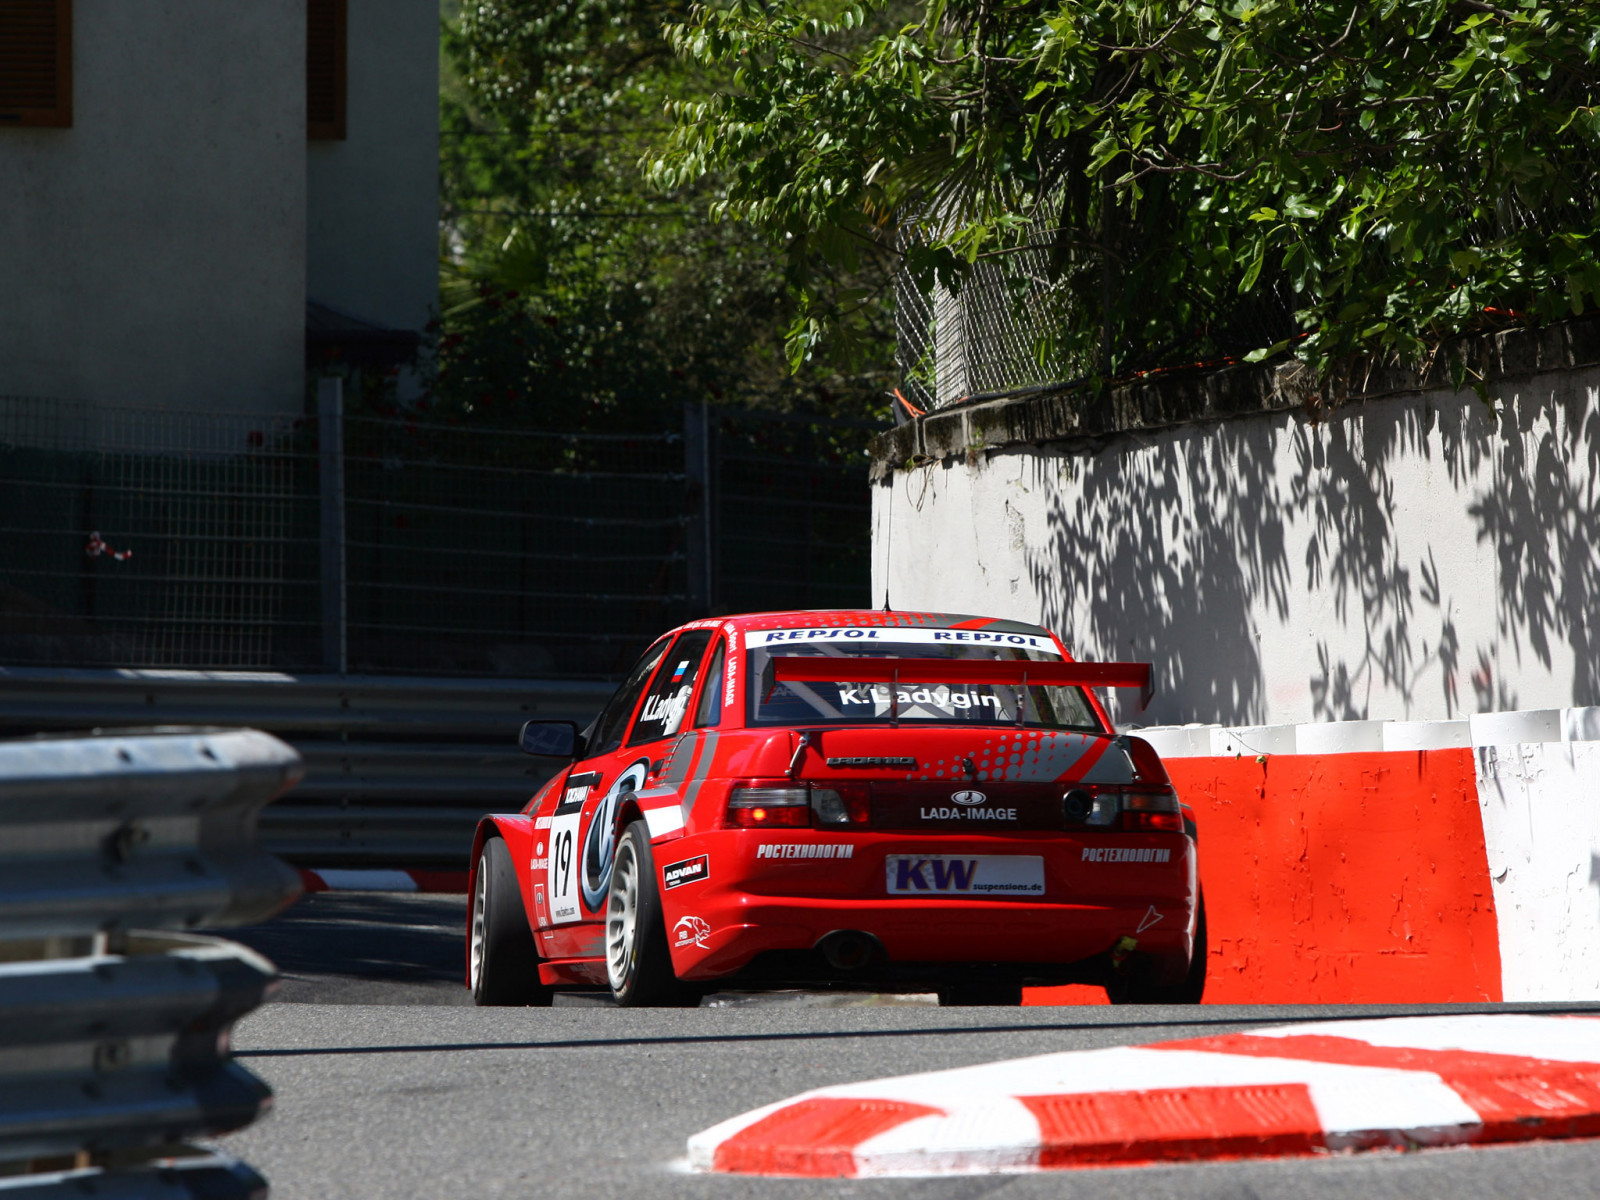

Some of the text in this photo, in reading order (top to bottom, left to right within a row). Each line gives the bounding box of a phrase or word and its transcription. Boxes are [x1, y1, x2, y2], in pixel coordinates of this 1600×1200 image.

[765, 630, 880, 642] REPSOL
[934, 632, 1042, 647] REPSOL
[838, 688, 1001, 708] K.Ladygin
[920, 807, 1018, 821] LADA-IMAGE
[756, 844, 854, 859] РОСТЕХНОЛОГИИ
[1081, 847, 1171, 863] РОСТЕХНОЛОГИИ
[554, 829, 572, 898] 19
[665, 863, 702, 882] ADVAN
[896, 859, 978, 891] KW
[973, 883, 1042, 892] suspensions.de
